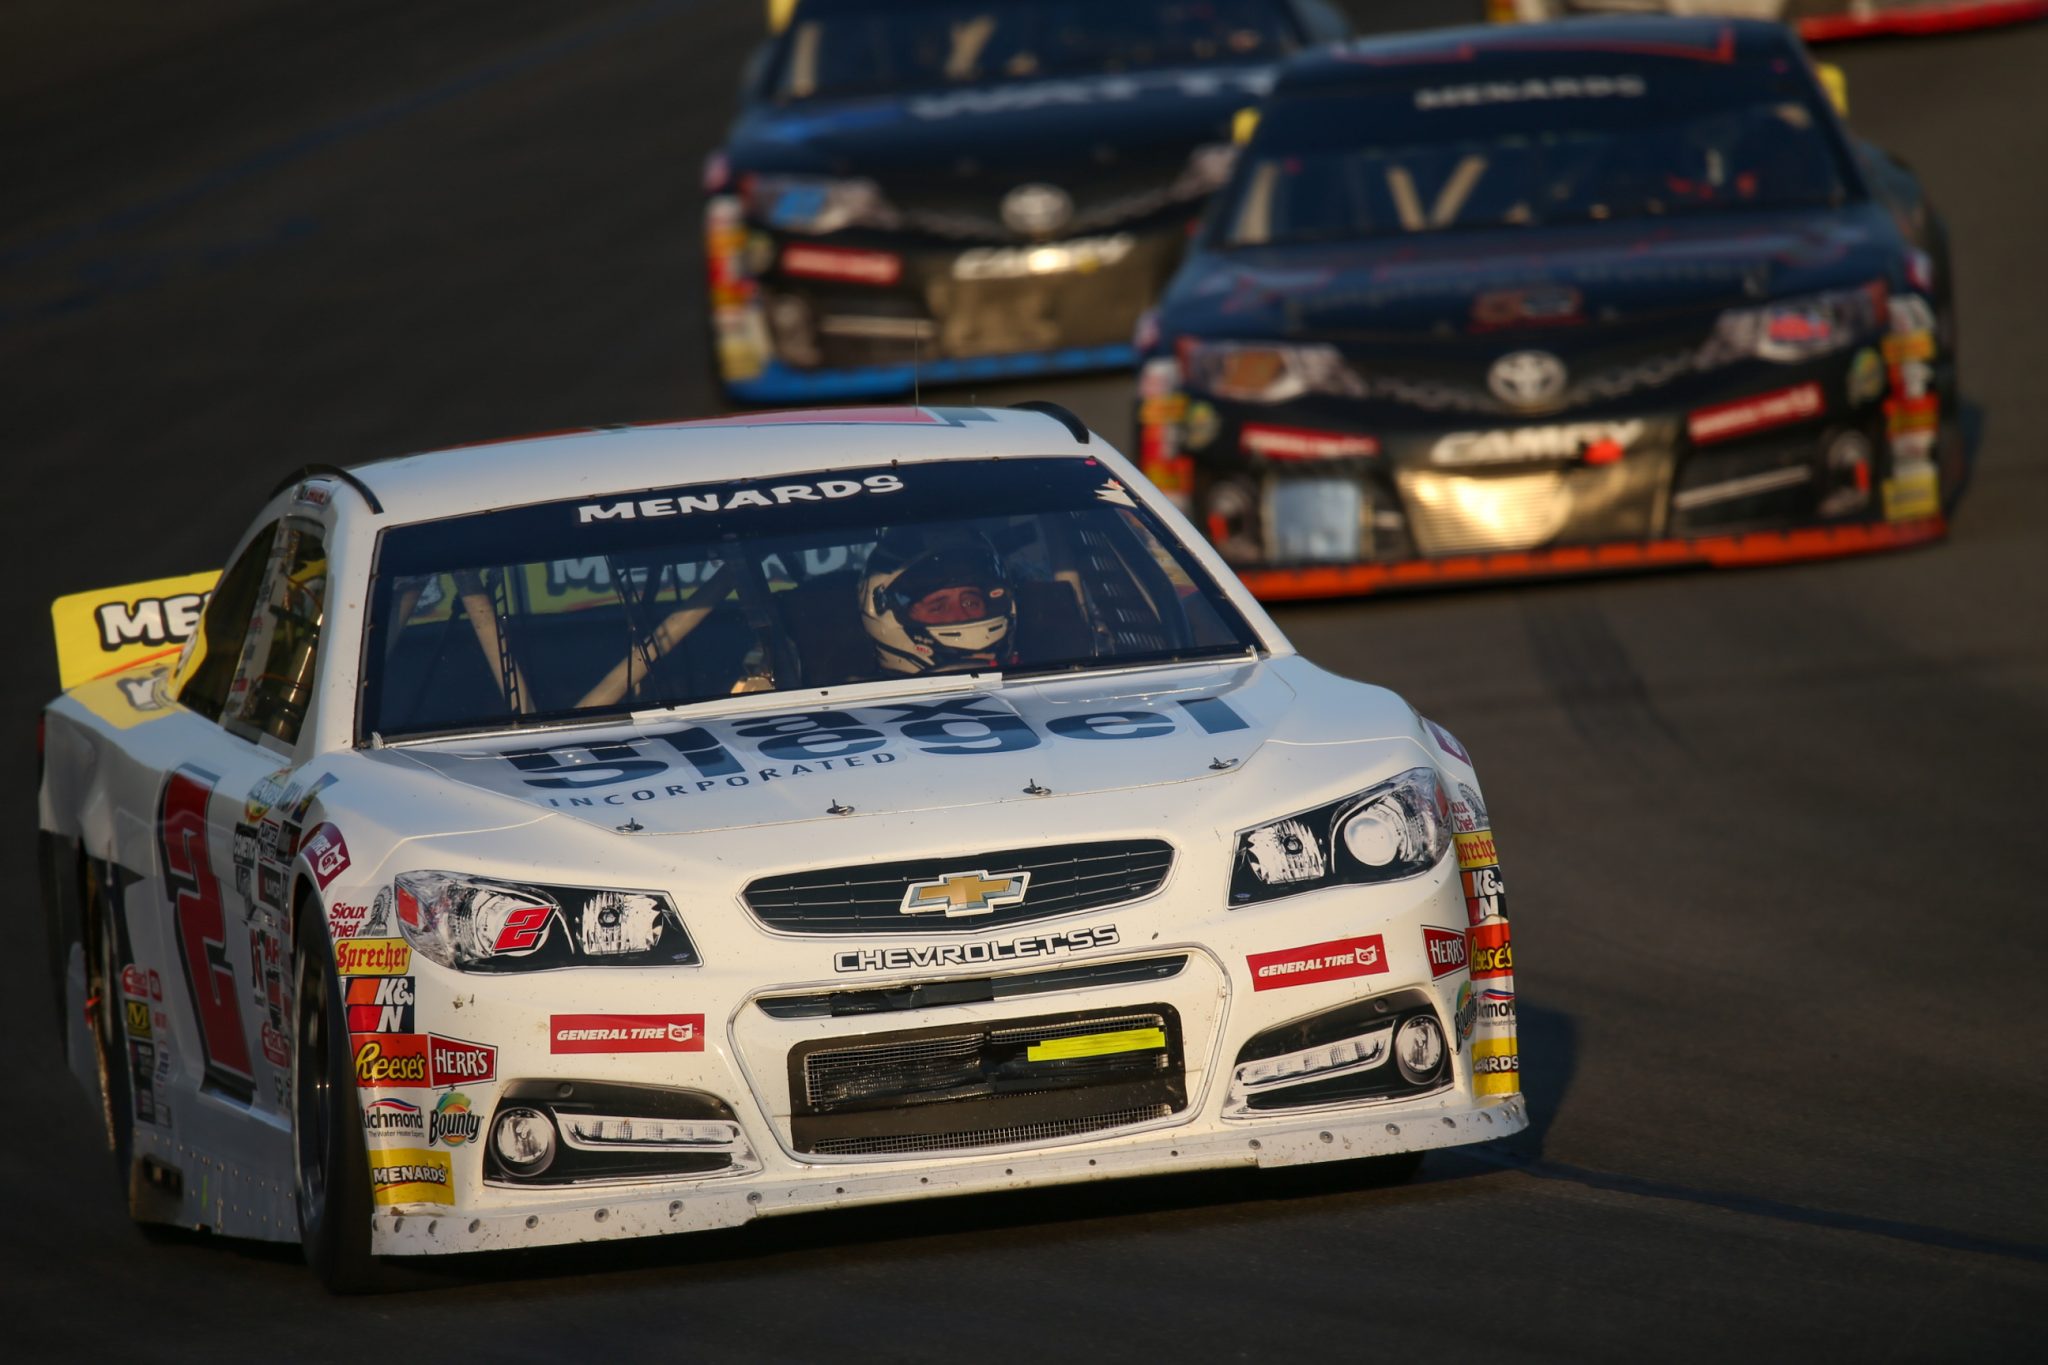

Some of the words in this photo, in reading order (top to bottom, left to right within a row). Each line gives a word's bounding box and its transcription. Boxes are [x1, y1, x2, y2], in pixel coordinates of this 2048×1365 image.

[578, 474, 904, 523] MENARDS
[97, 594, 213, 650] ME
[548, 753, 896, 807] INCORPORATED
[329, 902, 368, 919] Sioux
[328, 921, 360, 938] Chief
[491, 904, 560, 956] 2
[336, 941, 408, 974] Sprecher
[834, 933, 1062, 973] CHEVROLET
[1066, 924, 1121, 952] SS
[1430, 937, 1465, 965] HERR'S
[1258, 960, 1323, 978] GENERAL
[1323, 953, 1355, 968] TIRE
[556, 1028, 629, 1041] GENERAL
[630, 1028, 667, 1040] TIRE
[356, 1043, 426, 1080] Reese's
[434, 1048, 489, 1077] HERR'S
[429, 1110, 482, 1147] Bounty
[373, 1164, 446, 1184] MENARDS
